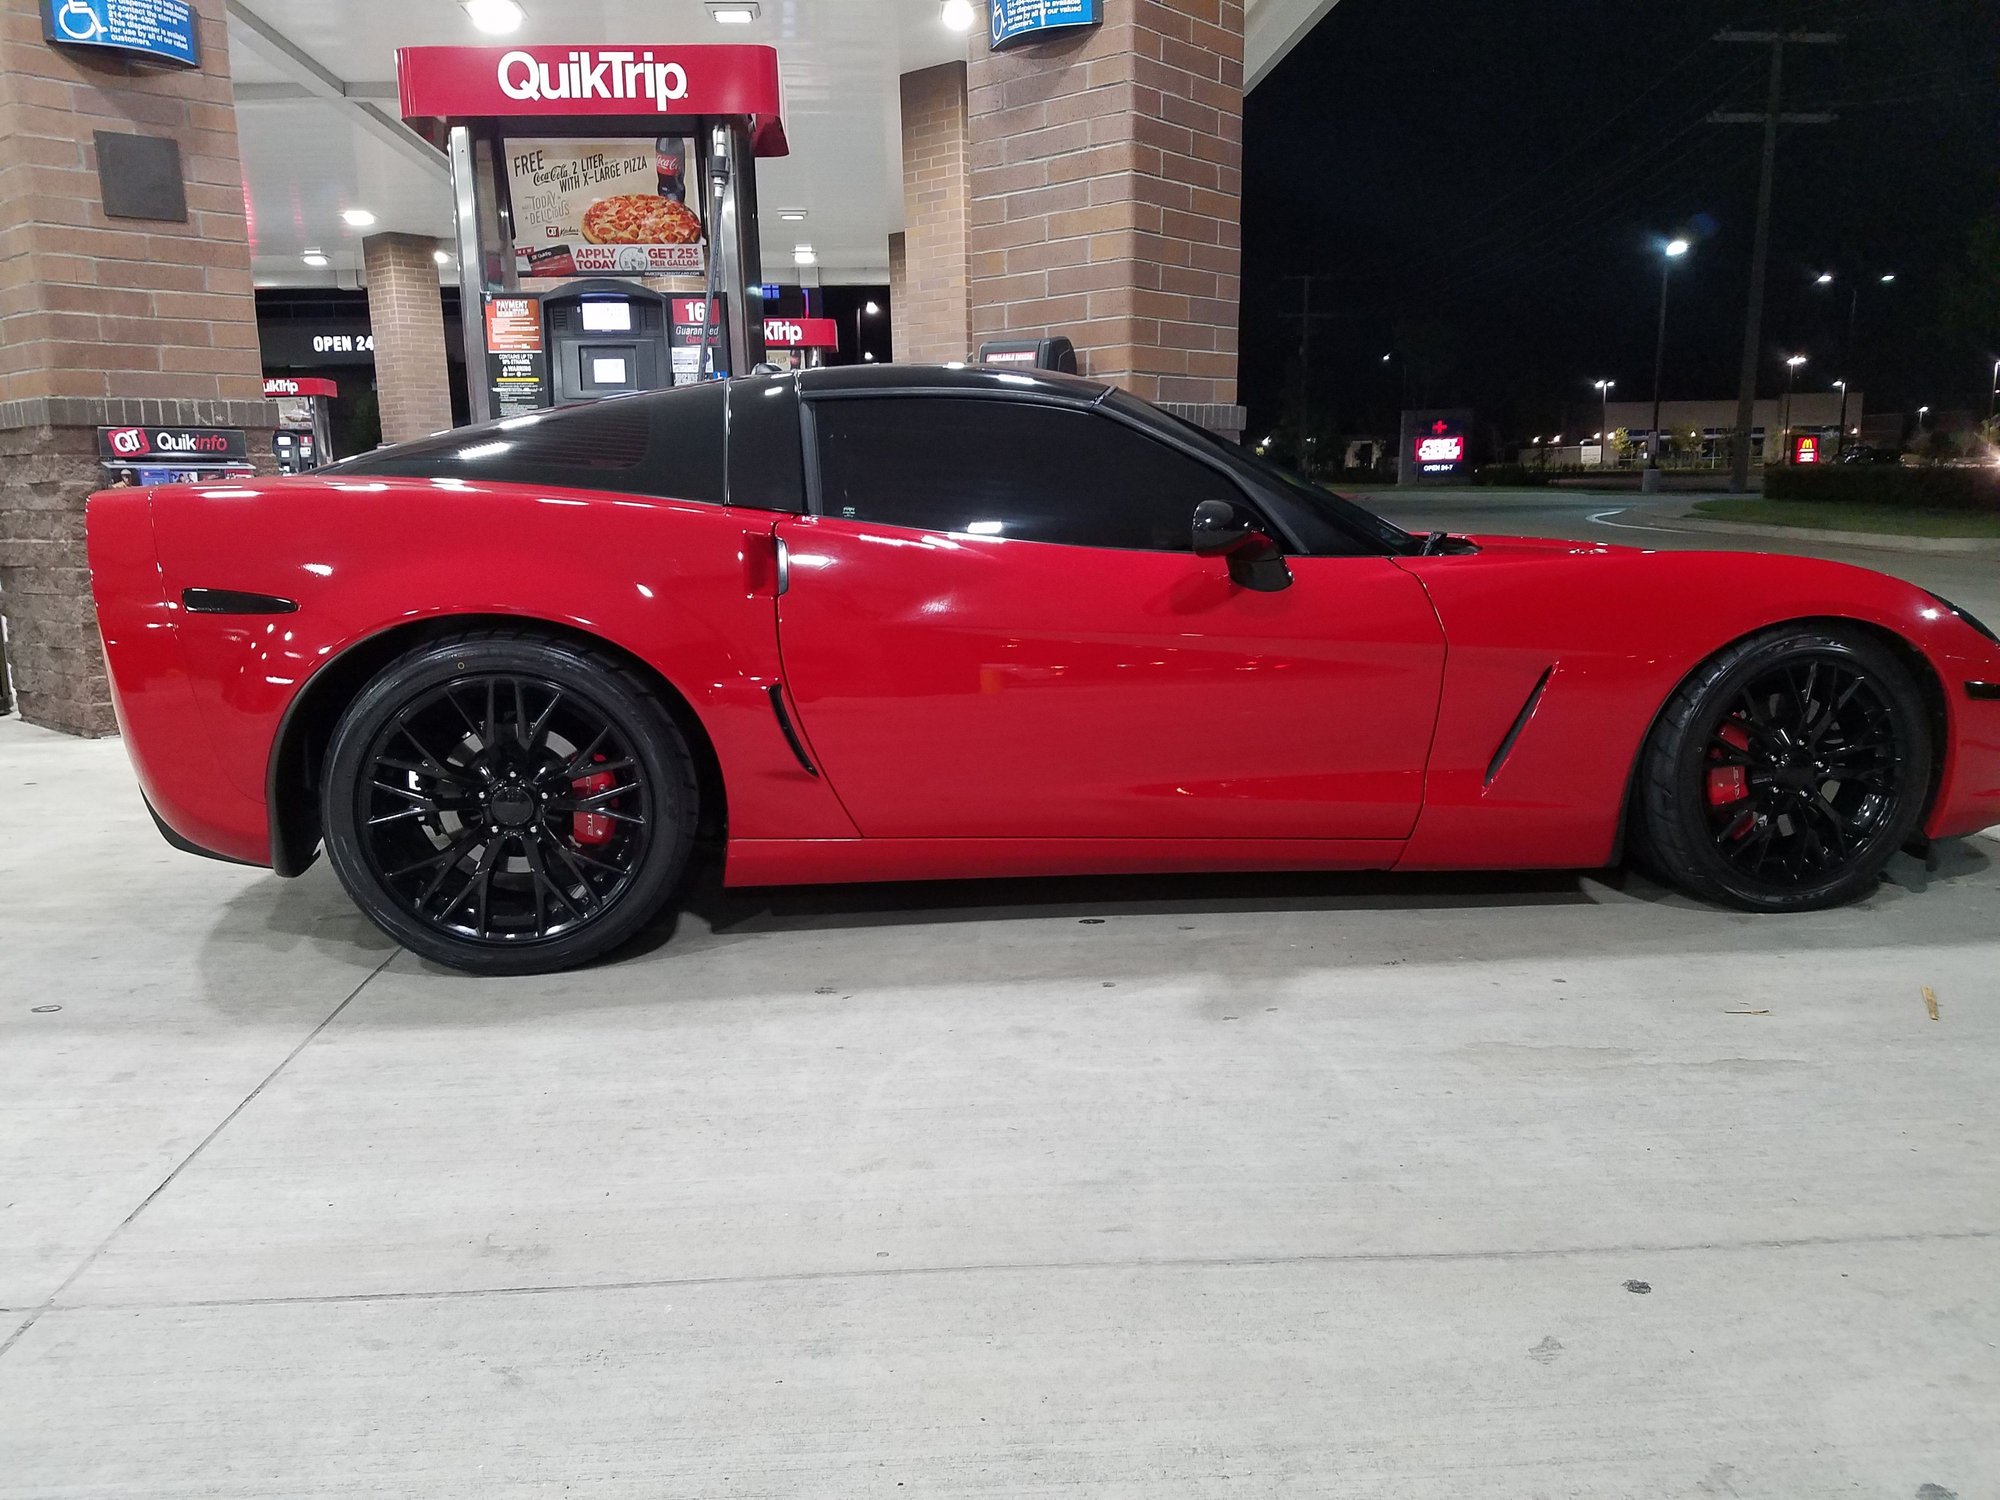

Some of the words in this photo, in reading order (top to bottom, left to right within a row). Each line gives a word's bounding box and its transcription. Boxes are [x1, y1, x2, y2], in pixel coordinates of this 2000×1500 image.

[117, 5, 146, 16] contact
[146, 9, 157, 19] the
[158, 13, 171, 24] store
[1047, 6, 1059, 15] our
[1060, 4, 1082, 13] valued
[108, 17, 126, 27] This
[127, 20, 160, 34] dispenser
[166, 30, 188, 43] available
[109, 25, 121, 34] for
[122, 28, 137, 37] use
[137, 29, 147, 40] by
[110, 34, 152, 47] customers.
[497, 50, 689, 112] QuikTrip
[513, 150, 545, 178] FREE
[571, 160, 578, 175] 2
[581, 153, 605, 172] LITER
[559, 174, 581, 194] WITH
[583, 162, 622, 187] X-LARGE
[623, 155, 648, 175] PIZZA
[529, 200, 570, 225] DELICIOUS
[576, 248, 616, 259] APPLY
[647, 247, 675, 259] GET
[576, 259, 617, 270] TODAY
[650, 259, 664, 267] PER
[666, 259, 699, 267] GALLON
[496, 300, 528, 310] PAYMENT
[685, 301, 705, 322] 16
[675, 325, 719, 336] Guaraned
[764, 321, 803, 345] kTrip
[313, 336, 352, 352] OPEN
[355, 336, 375, 351] 24
[263, 379, 299, 394] uikTrip
[114, 430, 141, 452] QT
[156, 432, 228, 451] Quikinfo
